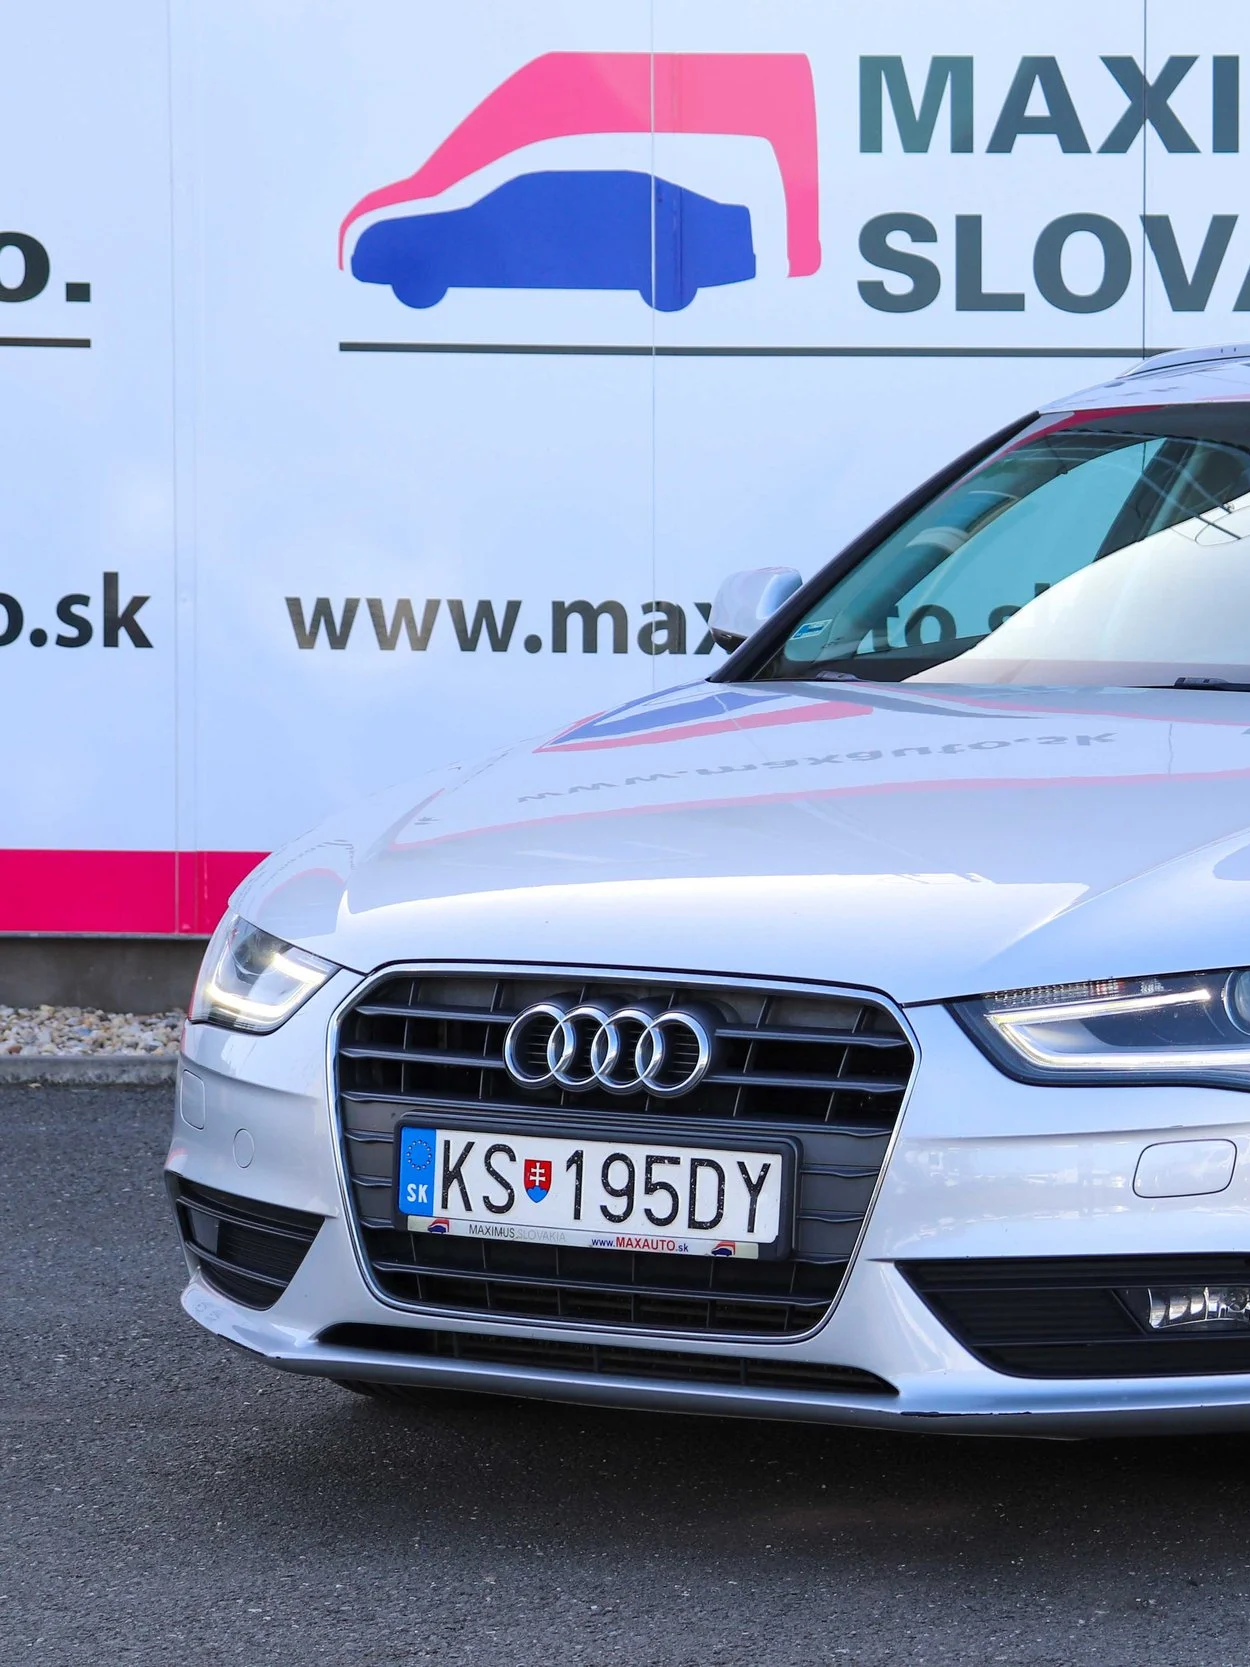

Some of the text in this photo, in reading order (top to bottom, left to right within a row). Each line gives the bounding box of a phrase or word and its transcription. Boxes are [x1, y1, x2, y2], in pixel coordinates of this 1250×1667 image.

[407, 1182, 429, 1204] SK
[441, 1139, 772, 1233] KS 195DY
